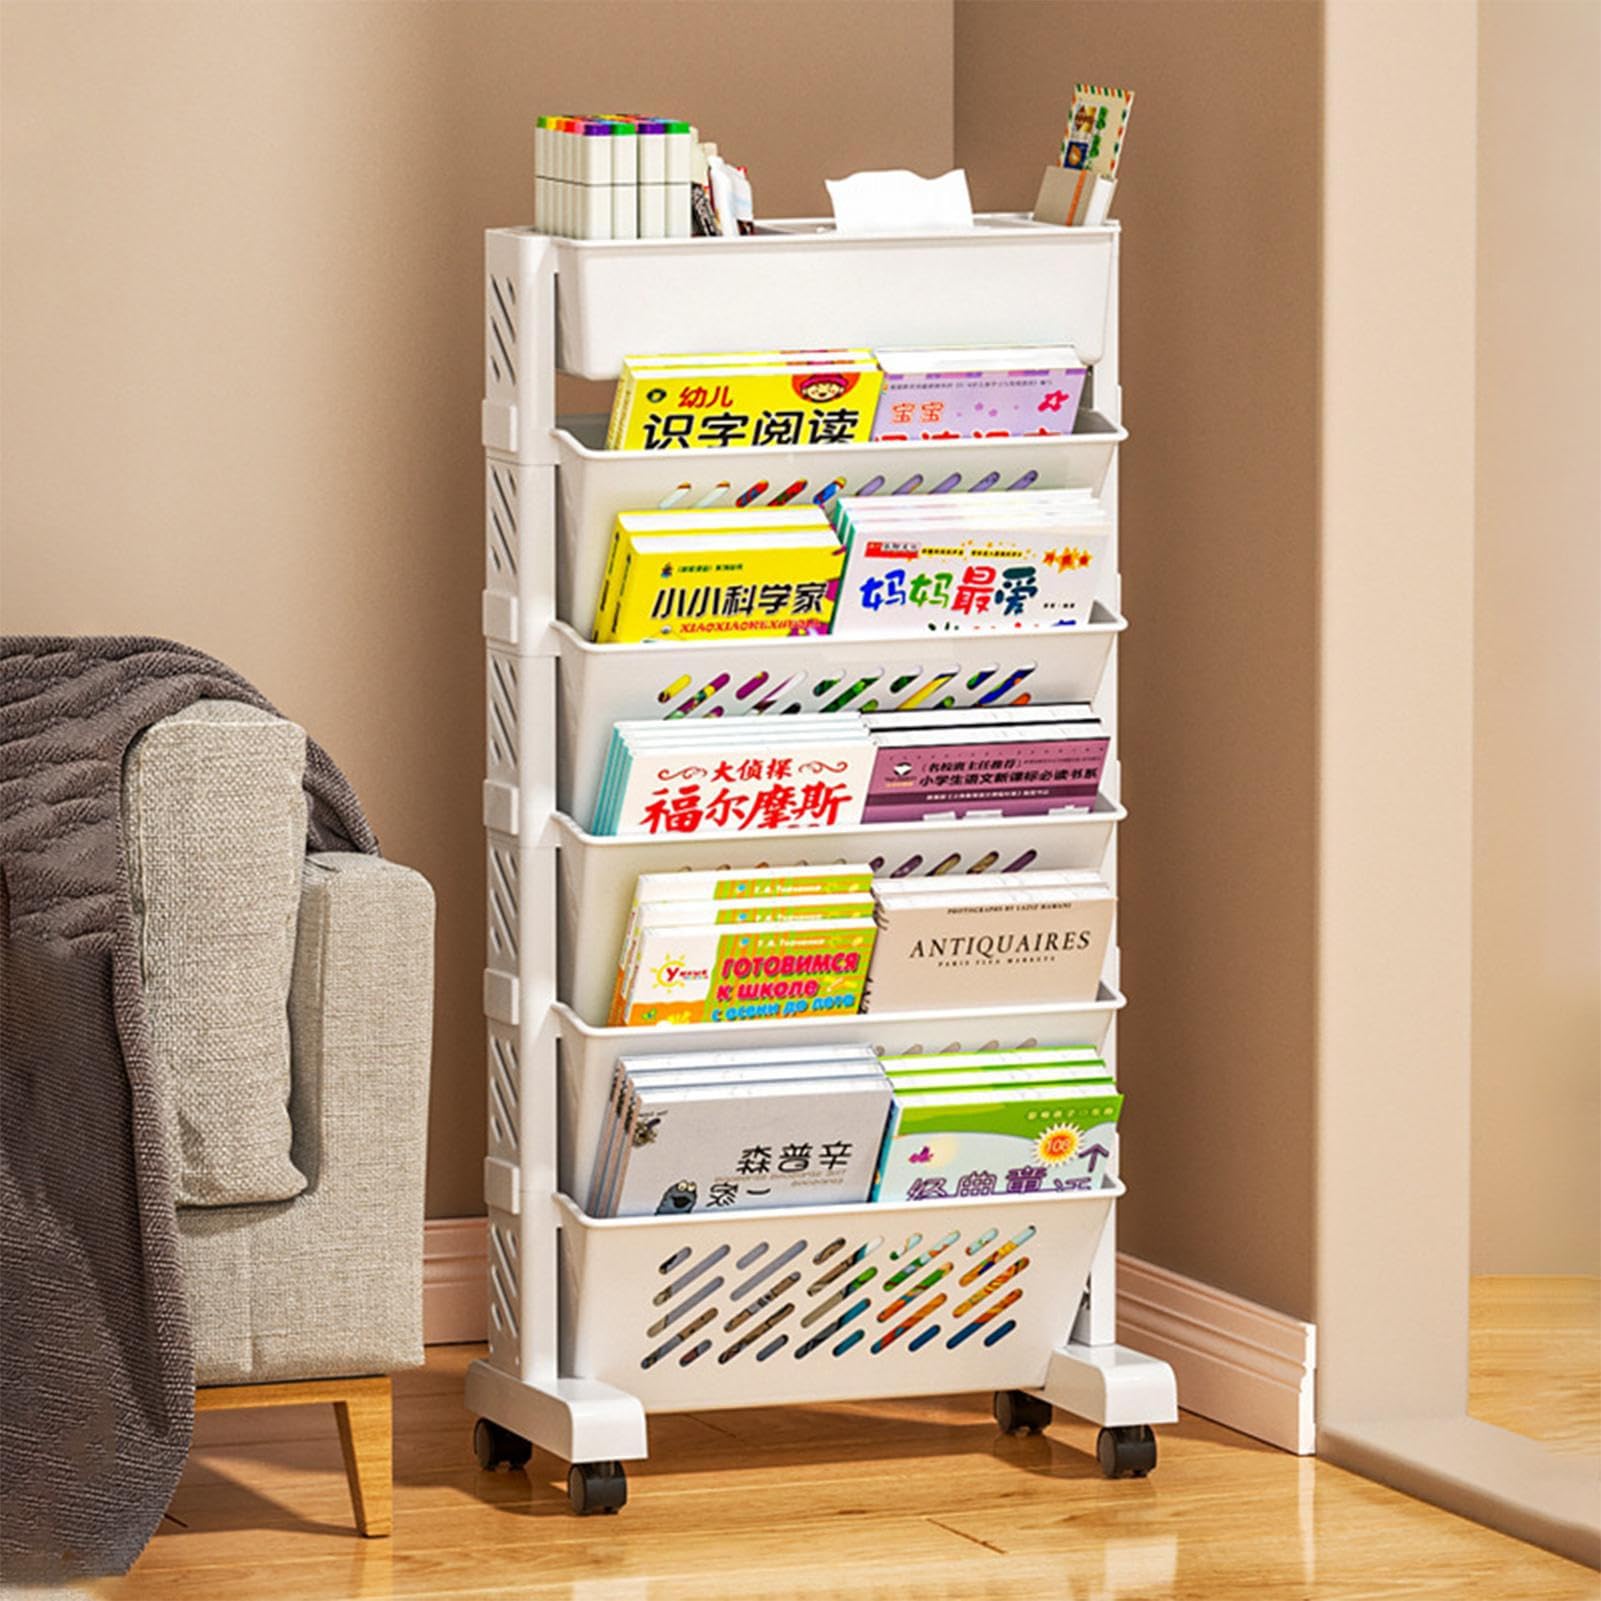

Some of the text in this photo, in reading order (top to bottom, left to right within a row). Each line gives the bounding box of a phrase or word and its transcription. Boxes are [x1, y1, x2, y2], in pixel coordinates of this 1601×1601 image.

[678, 386, 733, 408] 幼儿
[892, 401, 945, 424] 宝宝
[642, 408, 860, 449] 识字阅读
[651, 582, 827, 619] 小小科学家
[859, 566, 1038, 615] 妈妈最爱
[710, 758, 793, 783] 大侦探
[919, 768, 1098, 788] 小学生语文新课标必读书系
[640, 781, 853, 834] 福尔摩斯
[909, 931, 1091, 960] ANTIQUAIRES
[722, 952, 860, 979] ГОТОВИМСЯ
